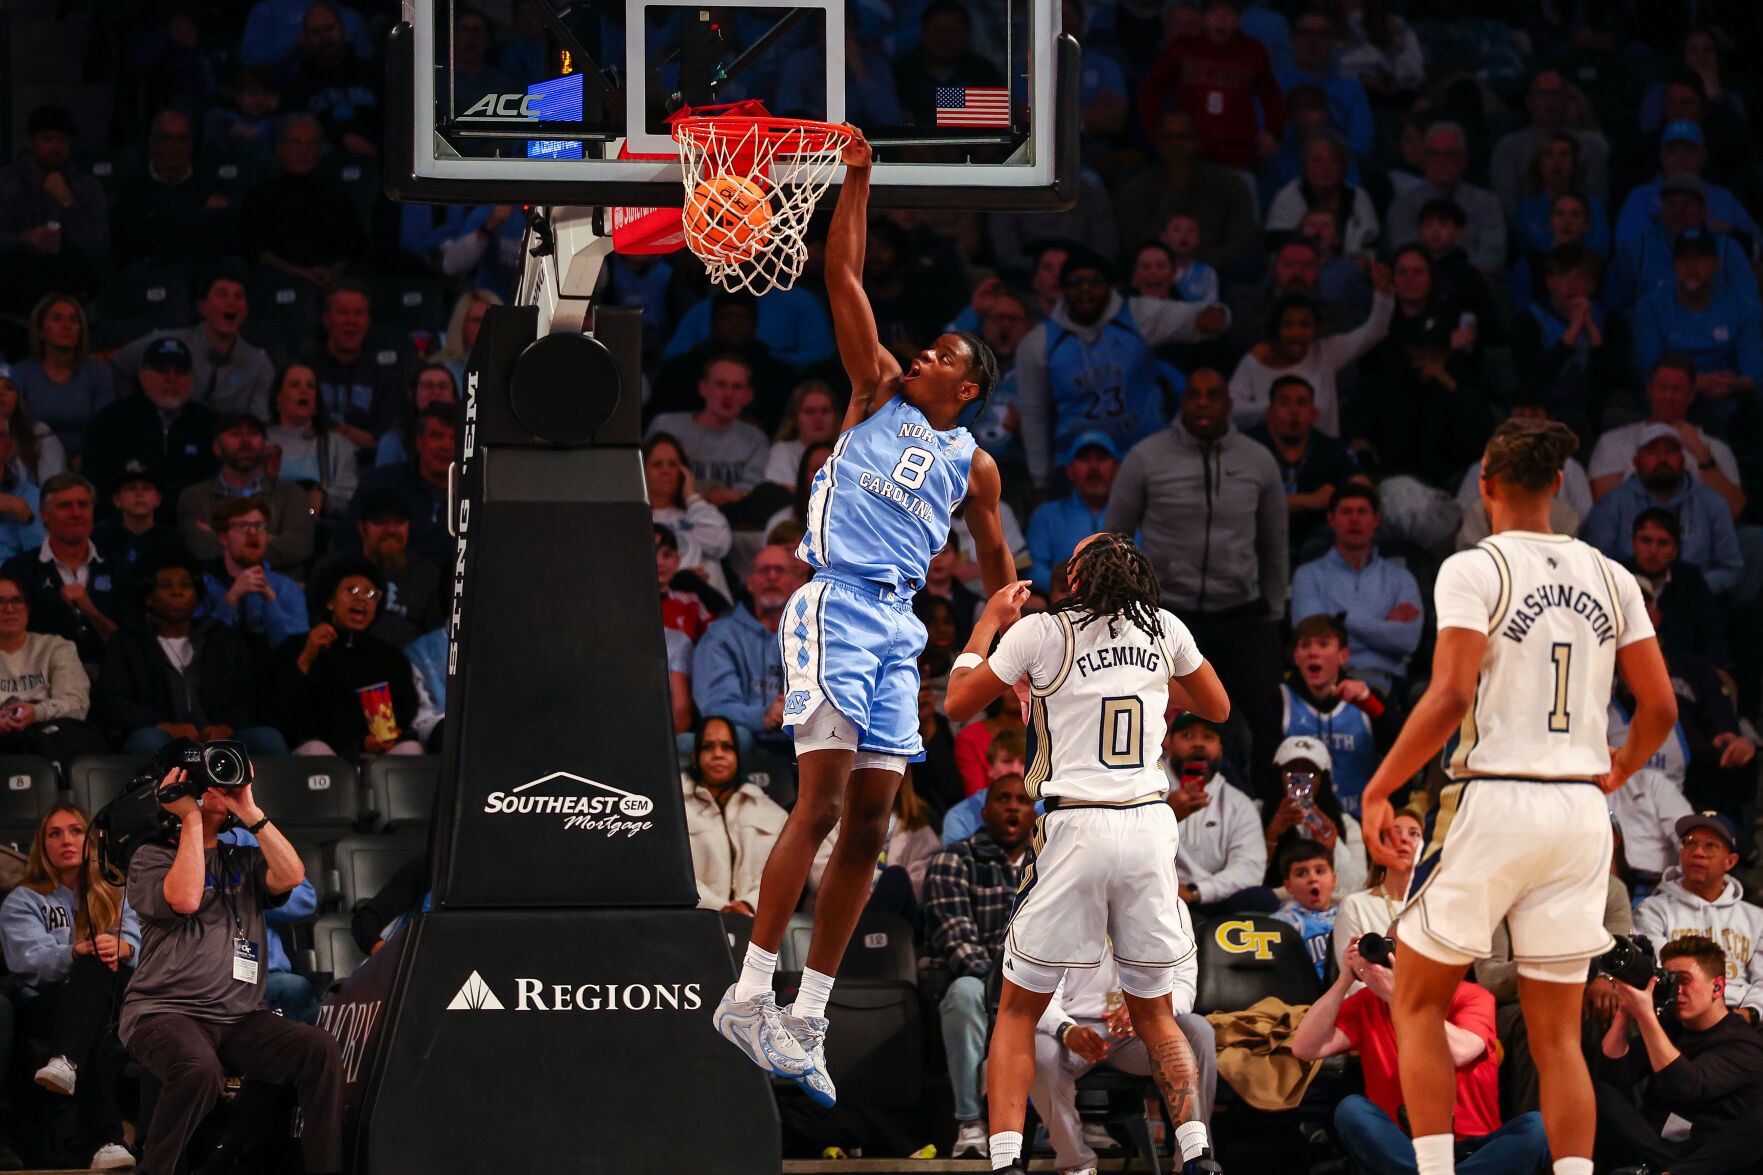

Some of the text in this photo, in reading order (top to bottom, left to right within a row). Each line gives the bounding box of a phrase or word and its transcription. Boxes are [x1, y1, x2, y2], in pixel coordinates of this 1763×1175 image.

[463, 93, 545, 116] ACC
[1083, 386, 1125, 419] 23
[897, 422, 942, 452] NOR
[891, 446, 935, 490] 8
[859, 472, 934, 523] CAROLINA
[448, 498, 470, 676] STING
[1502, 584, 1615, 647] WASHINGTON
[1076, 646, 1160, 678] FLEMING
[1548, 642, 1572, 733] 1
[1098, 695, 1145, 770] 0
[484, 791, 649, 814] SOUTHEAST SEM
[563, 814, 654, 838] Mortgage
[1215, 920, 1281, 960] GT
[514, 977, 702, 1011] REGIONS
